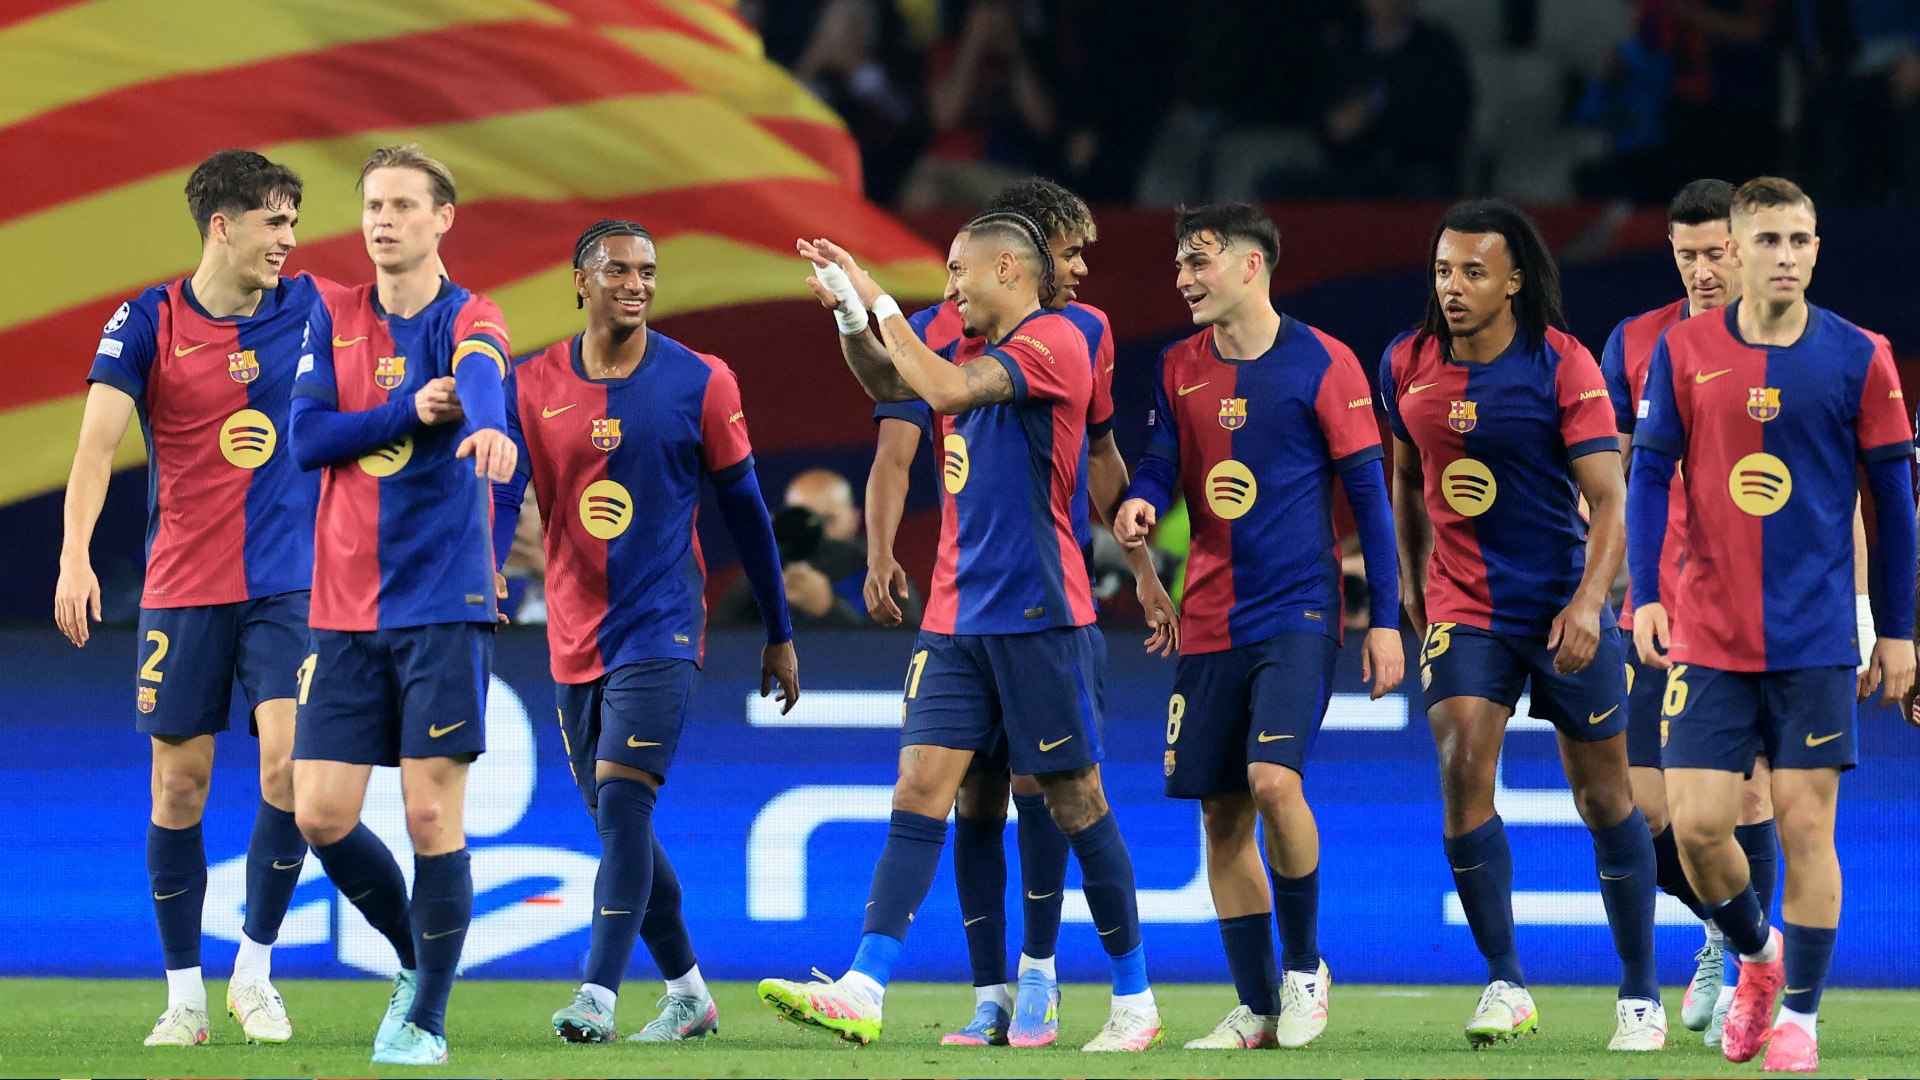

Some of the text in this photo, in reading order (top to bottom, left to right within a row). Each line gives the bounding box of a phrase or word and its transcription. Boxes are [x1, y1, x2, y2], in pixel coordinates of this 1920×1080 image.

[140, 630, 169, 683] 2
[296, 653, 318, 705] 1
[904, 649, 929, 699] 1
[1661, 664, 1689, 717] 6
[1166, 693, 1186, 744] 8
